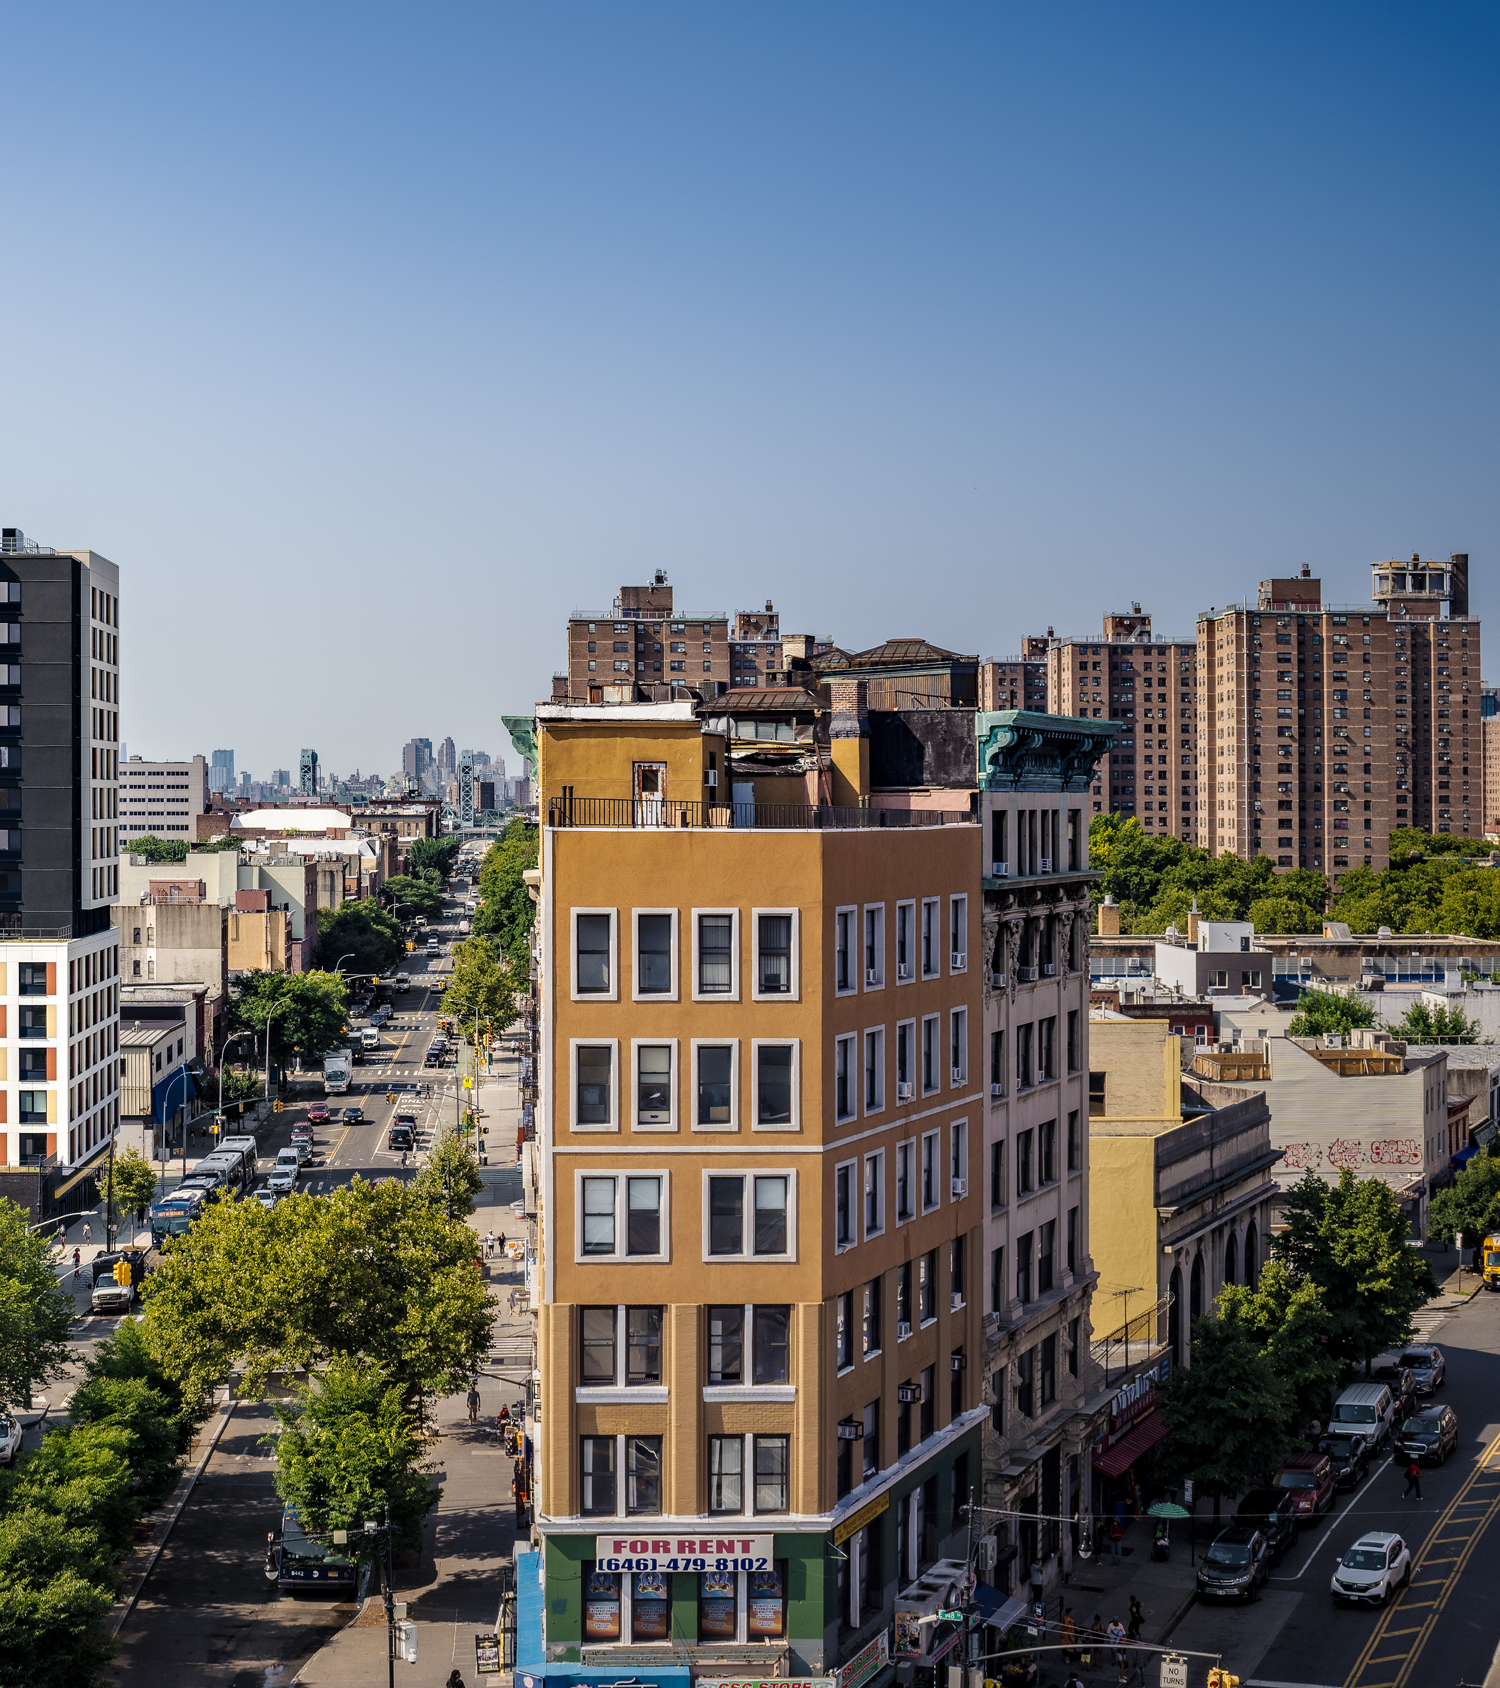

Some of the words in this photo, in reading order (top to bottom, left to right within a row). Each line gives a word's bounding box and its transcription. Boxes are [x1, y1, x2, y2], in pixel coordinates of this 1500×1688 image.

[612, 1539, 671, 1554] FOR
[677, 1539, 756, 1554] RENT
[598, 1557, 768, 1572] (646)-479-8102
[945, 1611, 955, 1619] 148
[842, 1660, 857, 1681] GSG
[858, 1638, 879, 1667] STORE
[1168, 1667, 1179, 1676] NO
[1162, 1676, 1185, 1686] TURNS
